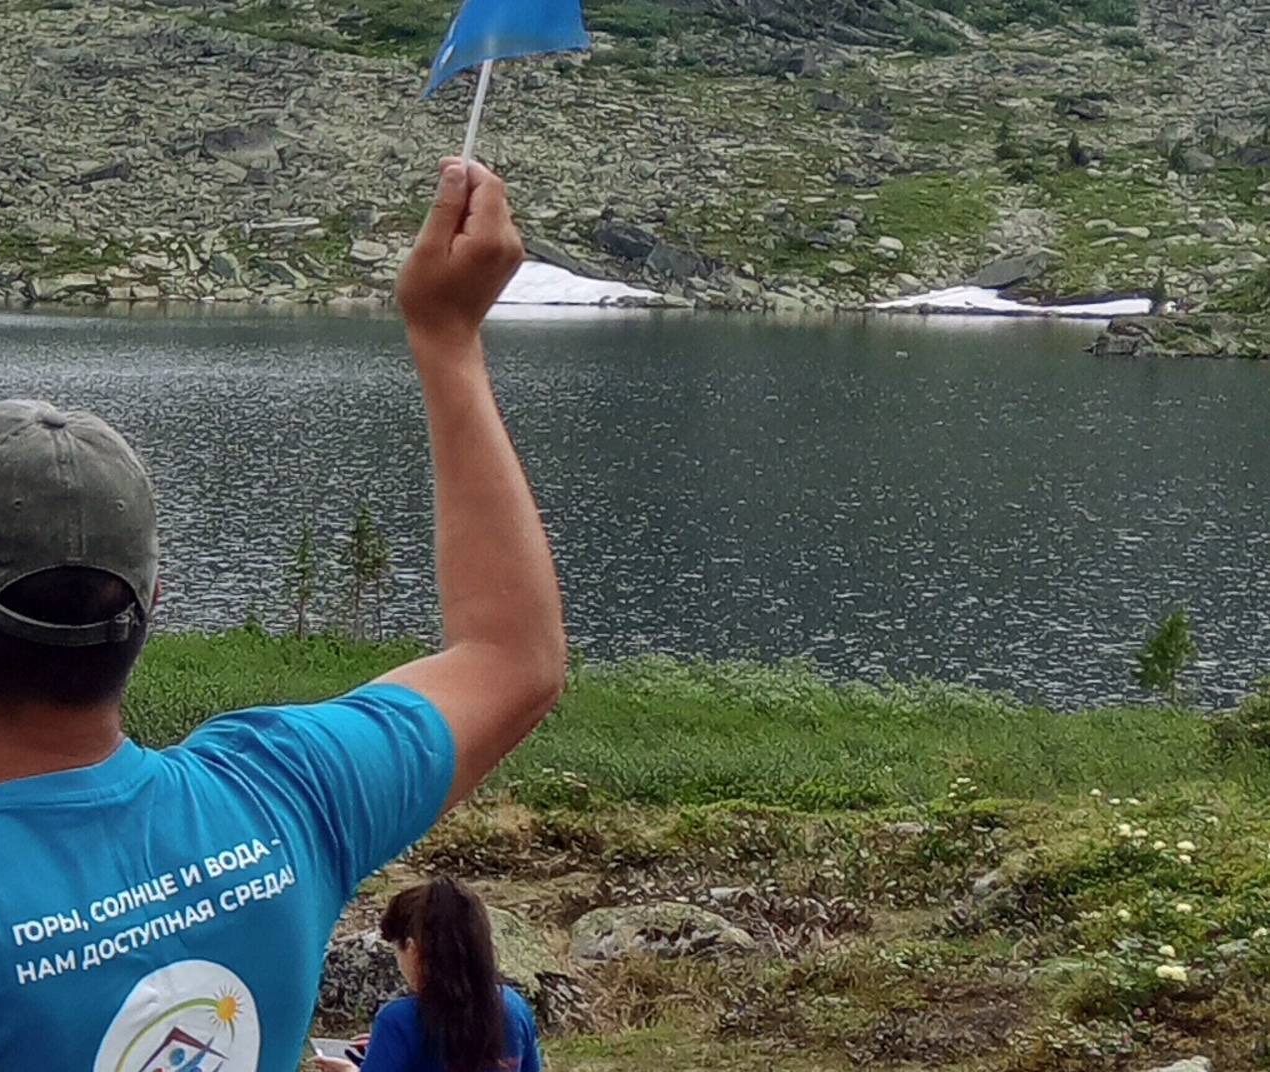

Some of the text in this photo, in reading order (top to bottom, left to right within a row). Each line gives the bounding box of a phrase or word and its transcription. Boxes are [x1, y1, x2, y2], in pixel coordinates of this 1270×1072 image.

[12, 909, 90, 946] ГОРЫ,
[90, 873, 179, 923] СОЛНЦЕ
[180, 864, 202, 888] И
[203, 838, 271, 879] ВОДА
[15, 863, 297, 985] НАМ ДОСТУПНАЯ СРЕДА!
